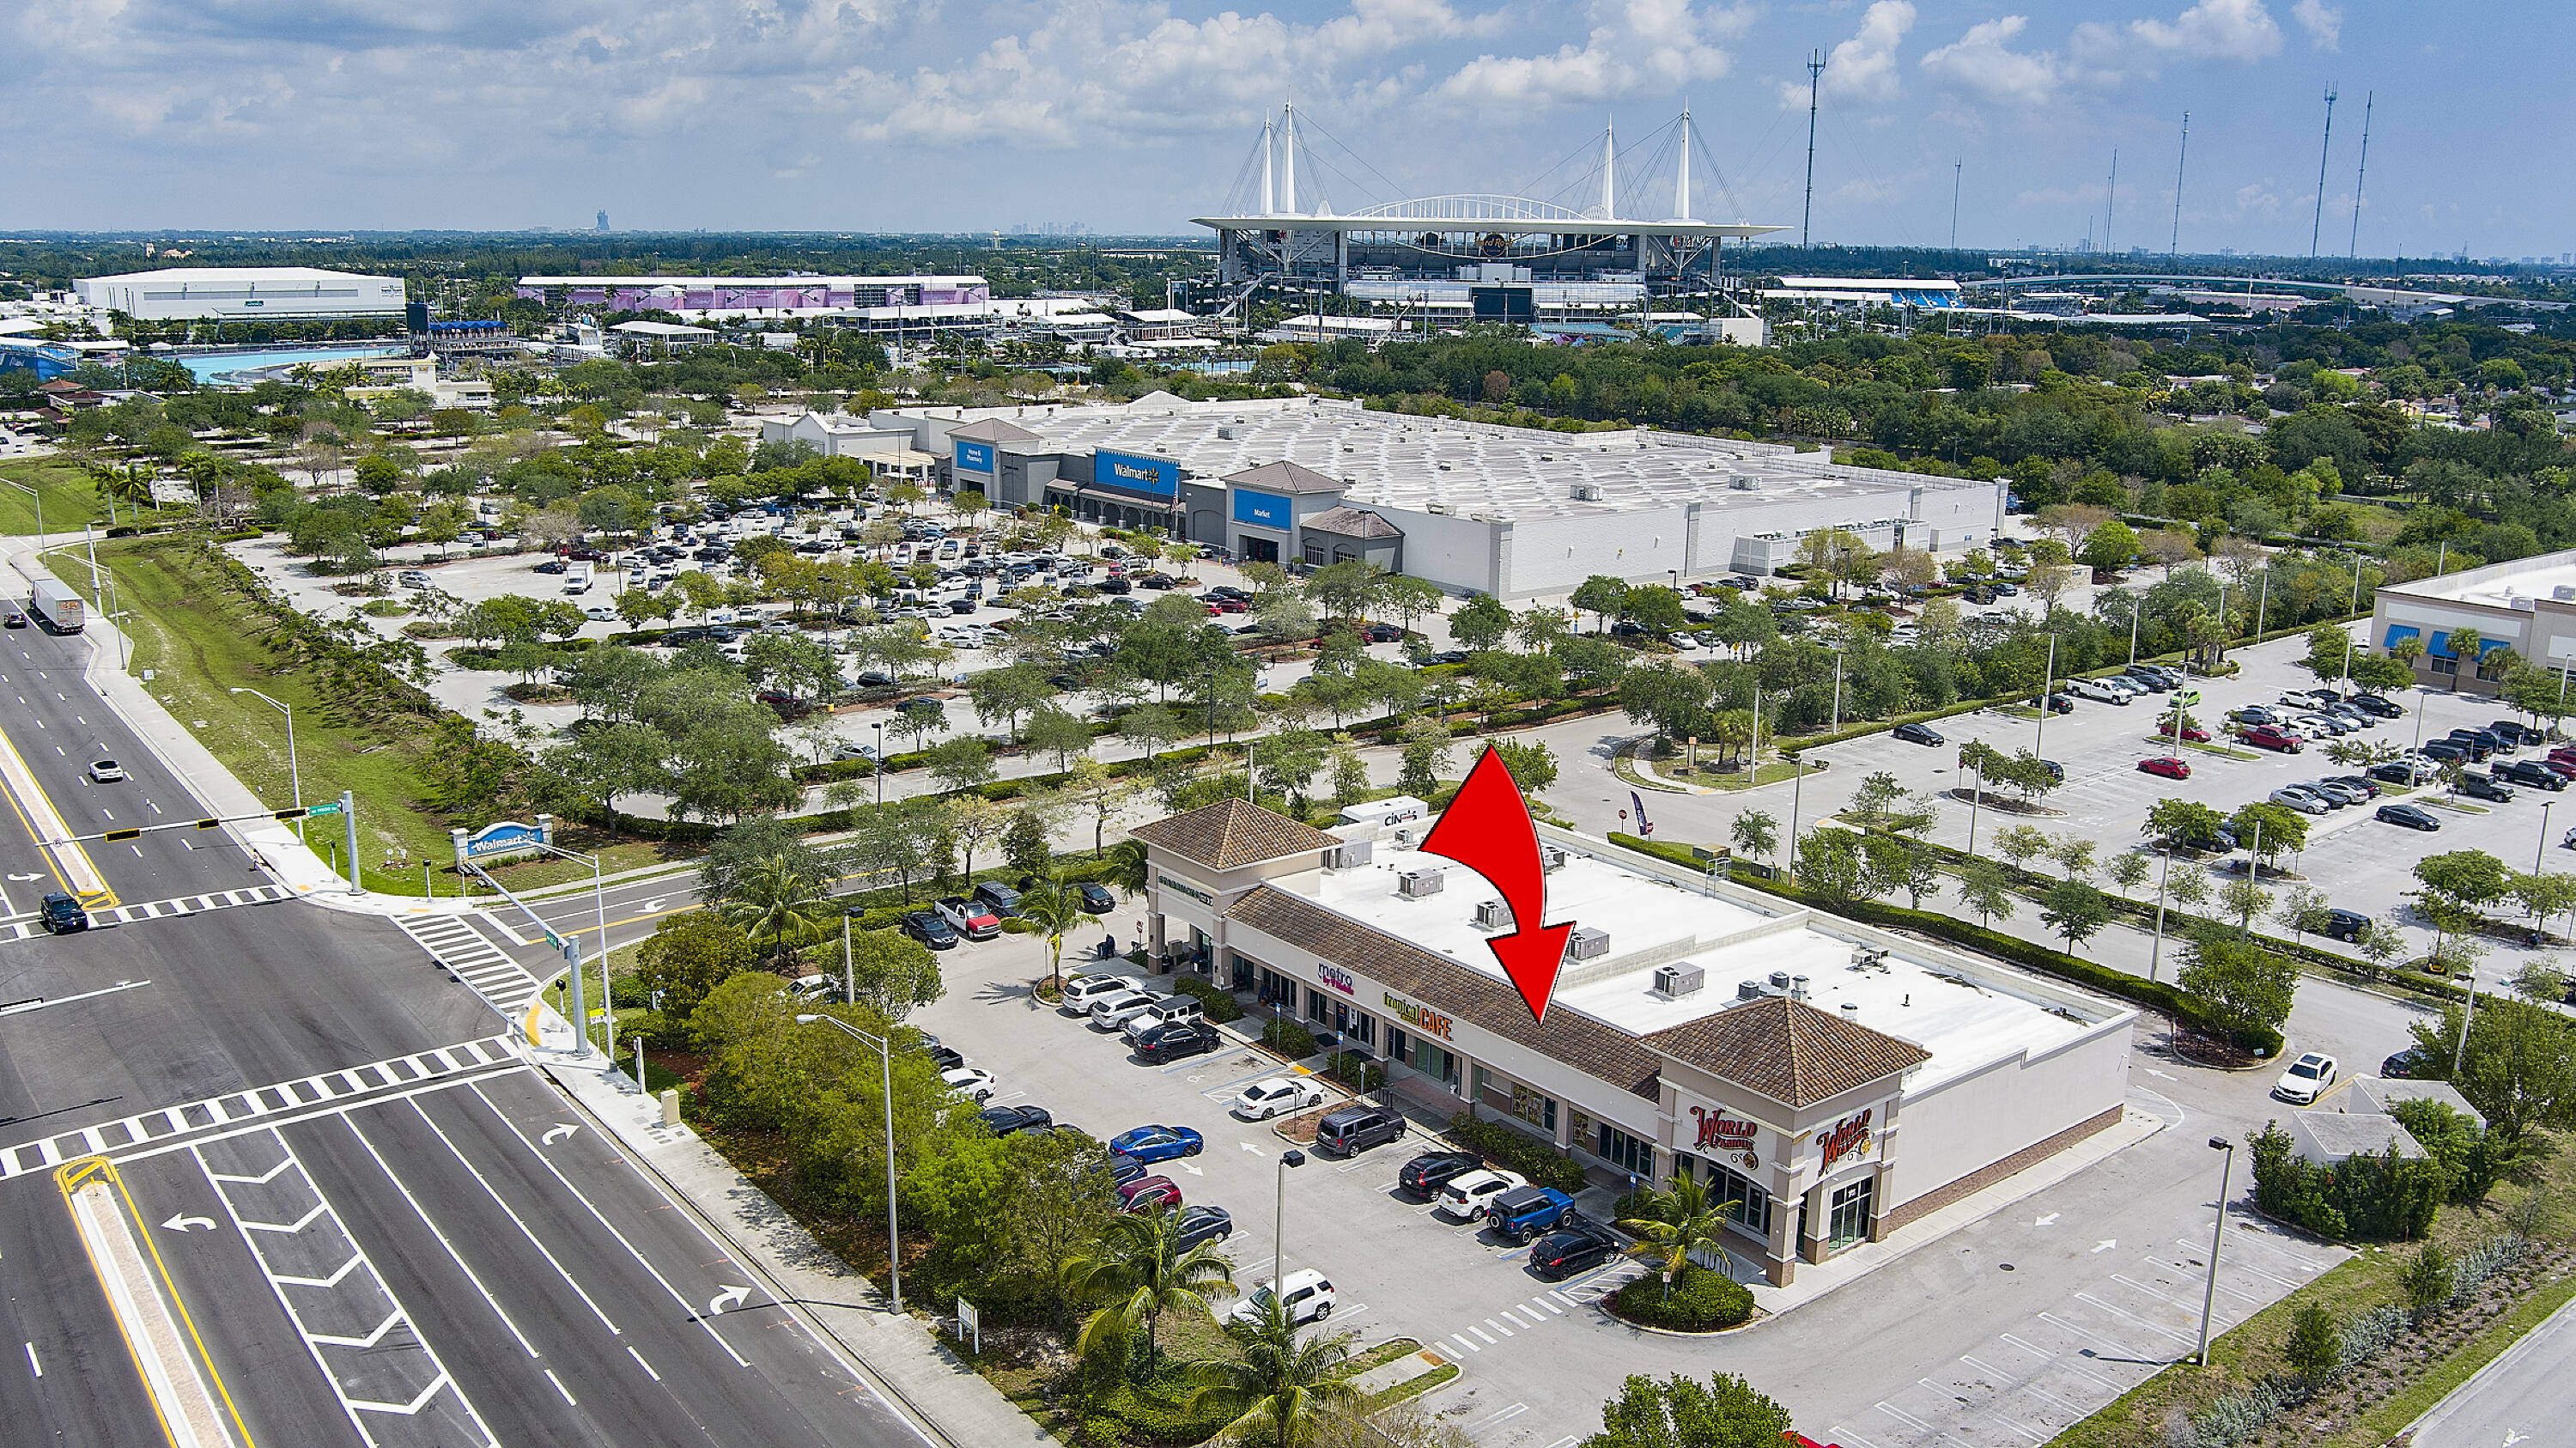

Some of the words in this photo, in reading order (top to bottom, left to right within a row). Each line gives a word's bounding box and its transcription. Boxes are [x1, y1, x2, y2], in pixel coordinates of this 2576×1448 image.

[1114, 463, 1149, 481] Walmart
[473, 834, 523, 852] Walmart
[1318, 962, 1353, 987] metro
[1383, 991, 1420, 1021] tropical
[1419, 1007, 1454, 1042] CAFE
